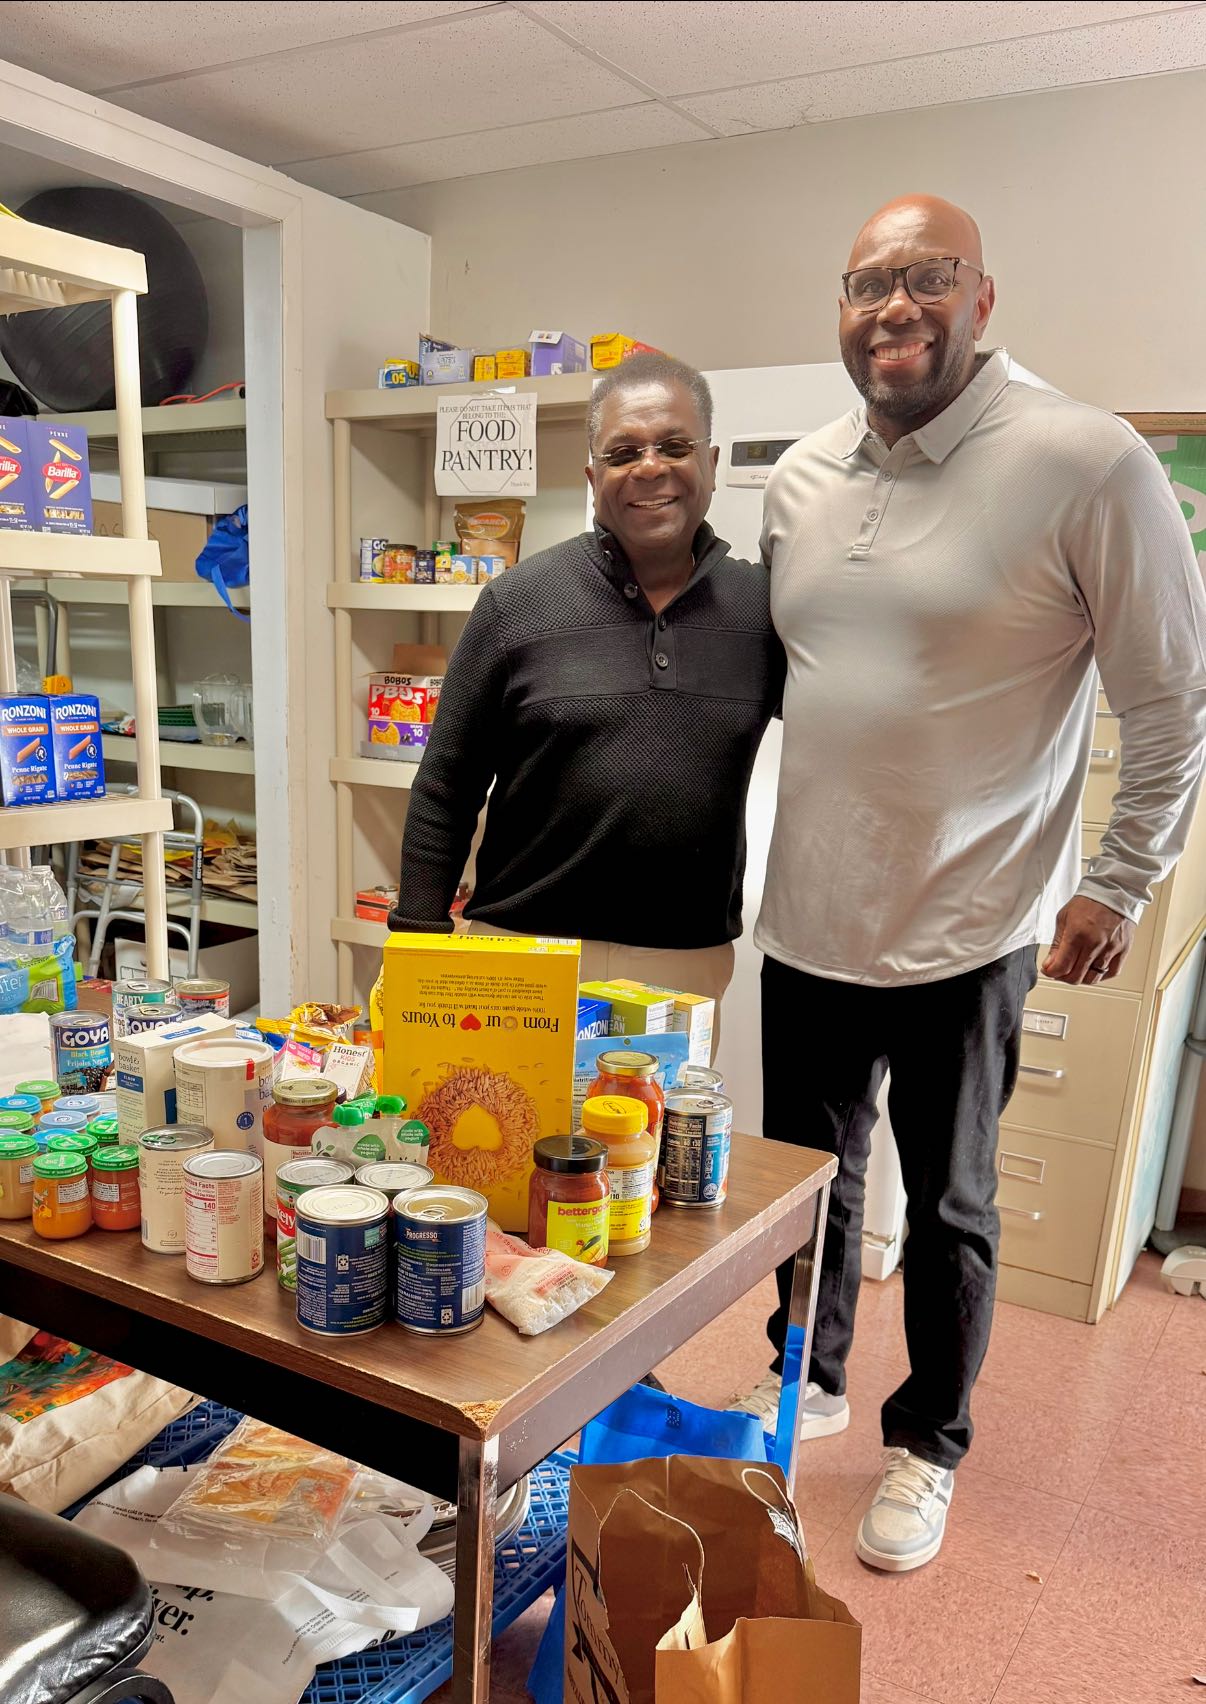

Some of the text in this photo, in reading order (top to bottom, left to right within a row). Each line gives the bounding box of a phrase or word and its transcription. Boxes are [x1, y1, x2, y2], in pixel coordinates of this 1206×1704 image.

[457, 420, 516, 442] FOOD
[442, 449, 533, 471] PANTRY!
[48, 466, 78, 479] Barilla
[384, 676, 412, 686] BOBOS
[2, 705, 46, 721] RONZONI
[56, 704, 97, 720] RONZONI
[371, 708, 380, 716] 10
[7, 726, 27, 734] WHOLE
[413, 729, 423, 737] 10
[12, 764, 48, 774] Penne Rigate
[0, 974, 23, 993] ter
[116, 994, 144, 1007] HEARTY
[402, 1011, 440, 1027] Yours
[442, 1014, 456, 1028] to
[523, 1016, 559, 1033] From
[62, 1030, 109, 1048] GOYA
[70, 1050, 88, 1058] Black
[334, 1046, 368, 1057] Honest
[118, 1060, 140, 1074] basket
[333, 1059, 360, 1067] ORGANIC
[406, 1231, 438, 1240] PROGRESSO
[155, 1633, 165, 1644] st.
